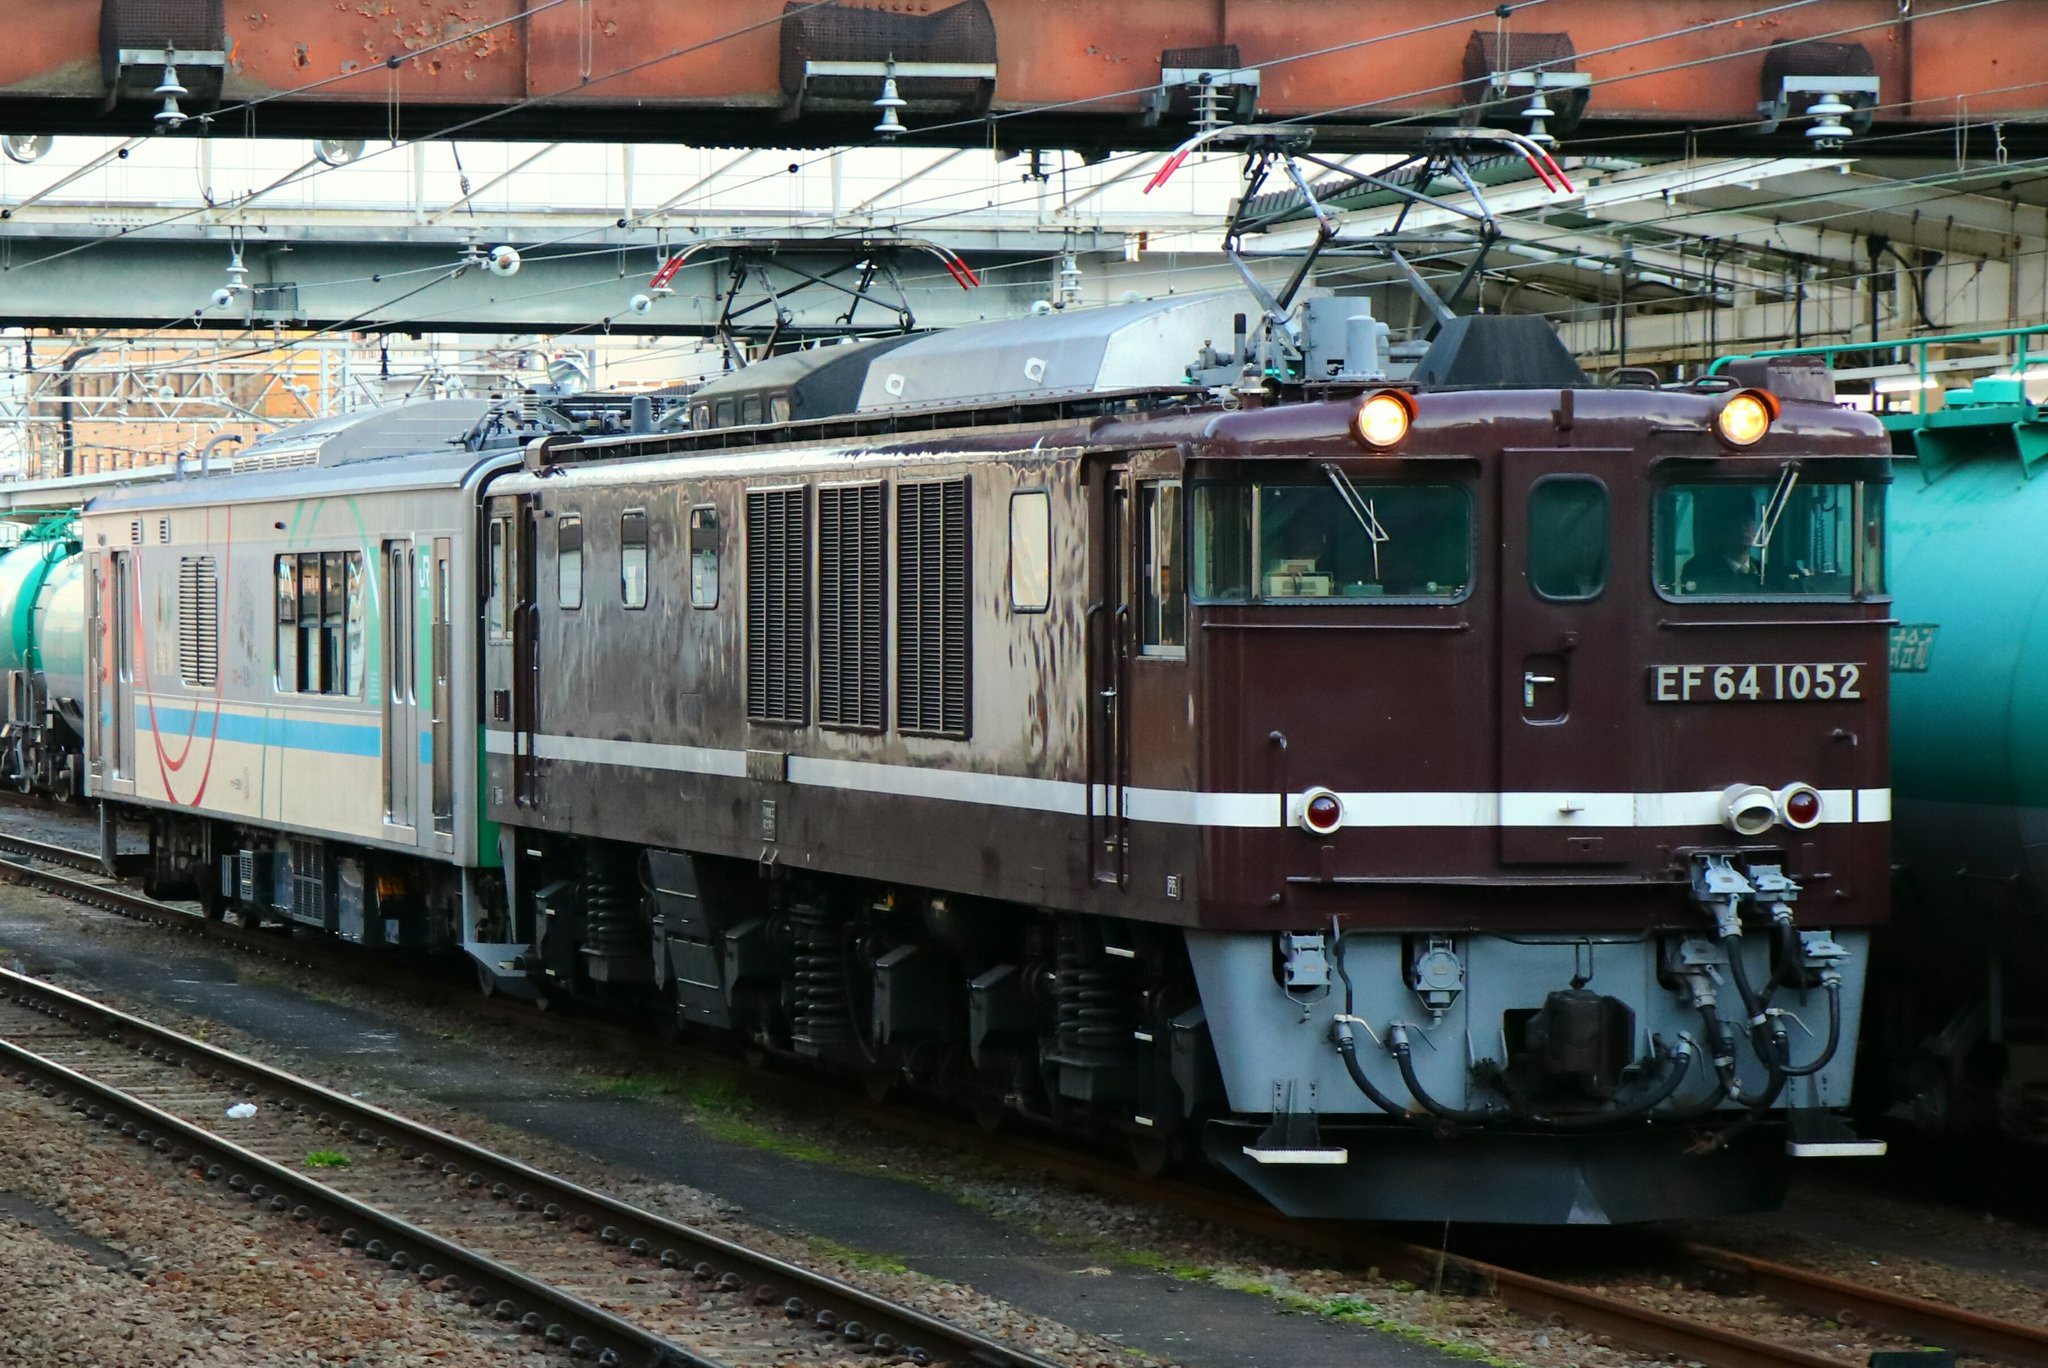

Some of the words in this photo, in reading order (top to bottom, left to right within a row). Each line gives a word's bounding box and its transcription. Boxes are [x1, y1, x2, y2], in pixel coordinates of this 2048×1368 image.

[419, 555, 430, 588] JR
[1657, 666, 1704, 701] EF
[1714, 665, 1760, 700] 64
[1775, 664, 1861, 700] 1052
